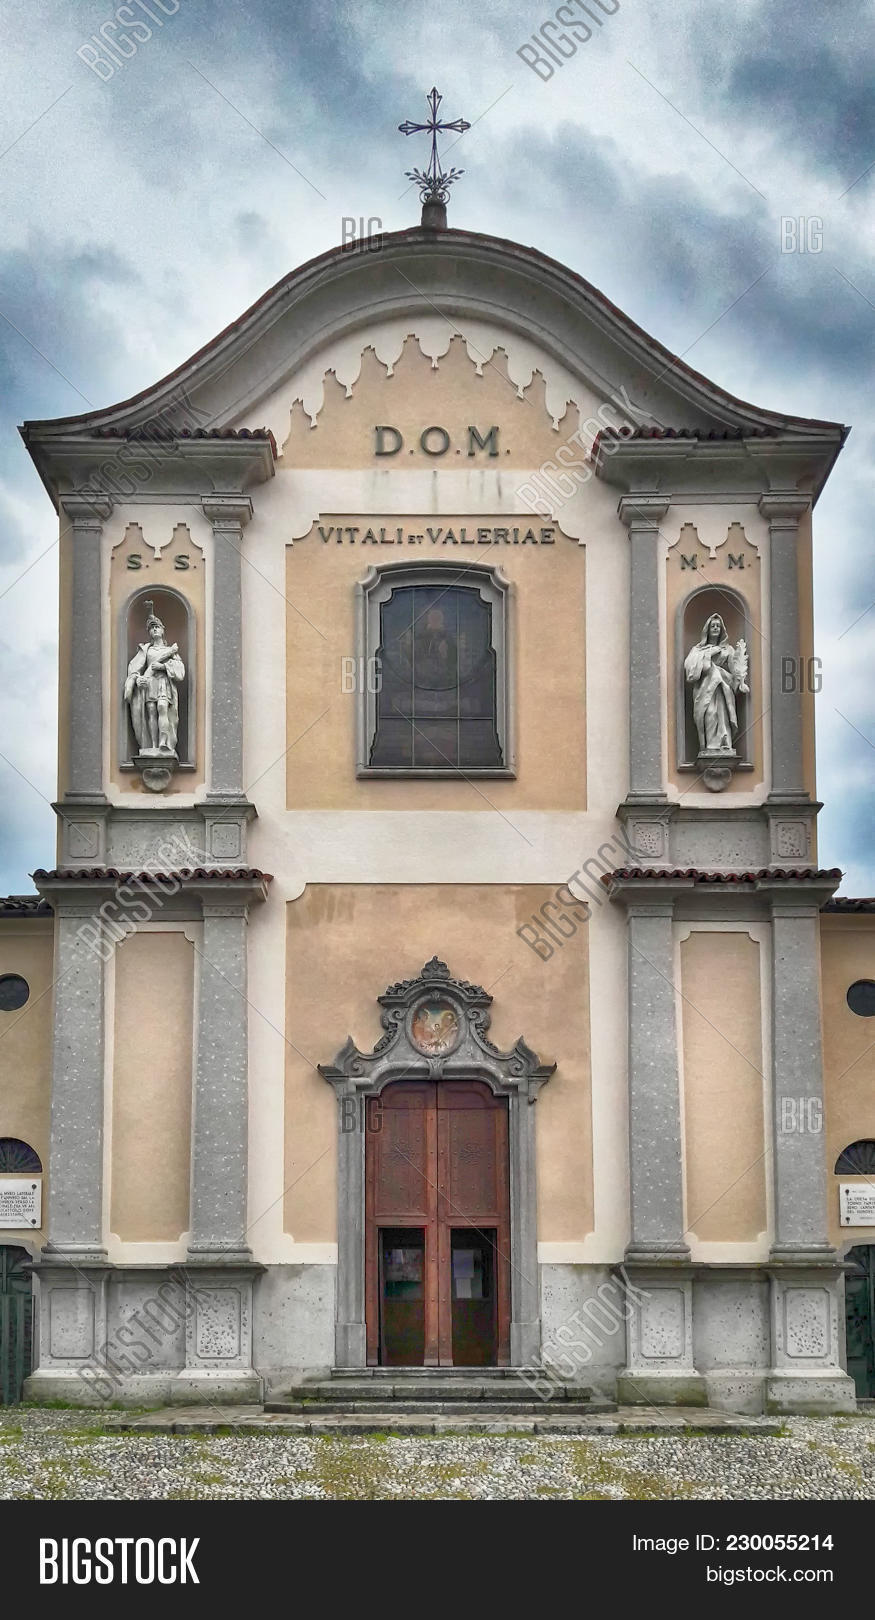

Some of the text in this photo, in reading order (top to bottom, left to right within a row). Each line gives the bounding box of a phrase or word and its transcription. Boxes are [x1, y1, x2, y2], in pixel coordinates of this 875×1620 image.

[318, 526, 556, 544] VITALI ET VALERIAE
